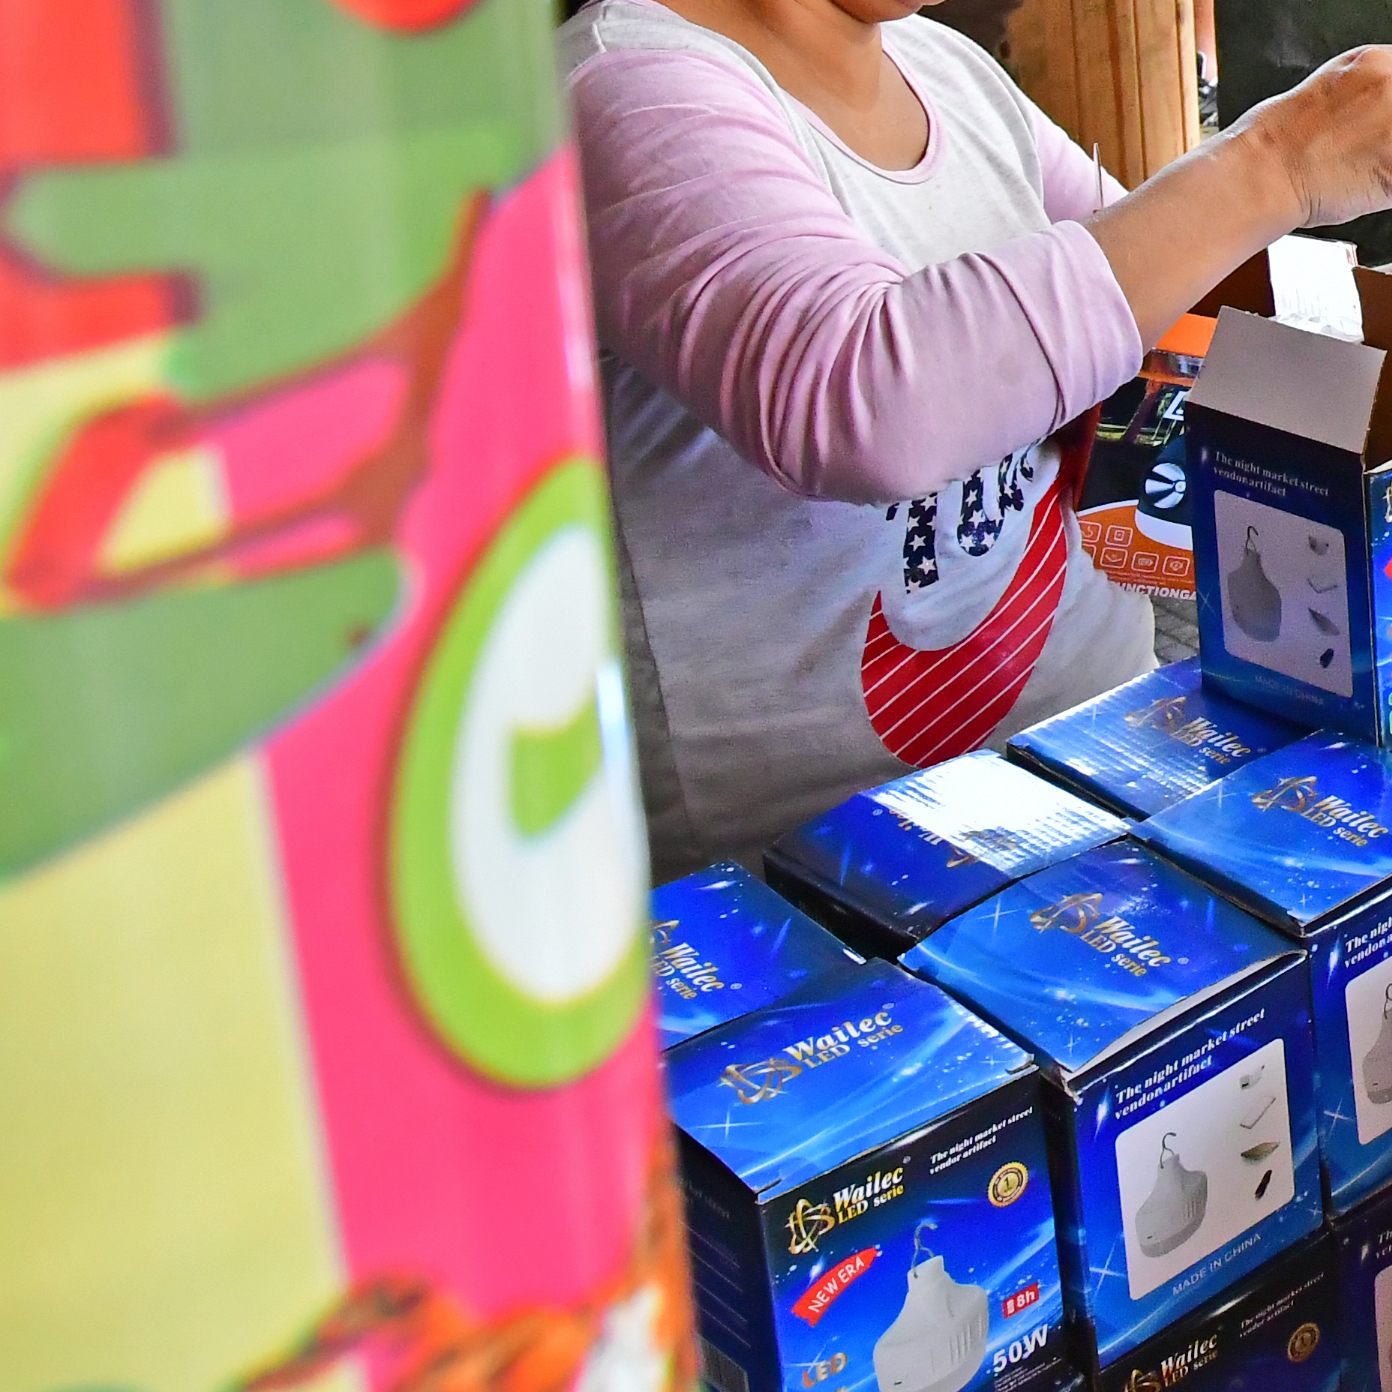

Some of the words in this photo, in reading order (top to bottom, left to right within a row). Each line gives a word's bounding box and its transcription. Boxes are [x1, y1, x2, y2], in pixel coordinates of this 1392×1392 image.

[1215, 451, 1232, 467] The
[1234, 459, 1260, 475] night
[1262, 466, 1299, 487] market
[1300, 479, 1329, 497] street
[1184, 716, 1252, 759] Wailec
[1199, 744, 1231, 765] serie
[1301, 807, 1337, 829] LED
[1332, 825, 1368, 848] serie
[1313, 795, 1389, 839] Wailec
[1080, 929, 1117, 954] LED
[1111, 953, 1148, 978] serie
[1093, 915, 1171, 967] Wailec
[1344, 939, 1385, 968] vendor
[1345, 935, 1368, 953] The
[661, 942, 725, 993] Wailec
[665, 975, 698, 1000] serie
[782, 1010, 893, 1062] Wailec
[803, 1043, 851, 1069] LED
[857, 1024, 904, 1049] serie
[1116, 1084, 1142, 1105] The
[1144, 1060, 1179, 1089] night
[1181, 1029, 1227, 1068] market
[1229, 1008, 1266, 1039] street
[1163, 1055, 1213, 1094] artifact
[929, 1156, 962, 1176] vendor
[962, 1134, 997, 1160] artifact
[930, 1151, 948, 1165] The
[949, 1136, 974, 1156] night
[974, 1117, 1007, 1144] market
[1007, 1106, 1034, 1126] street
[832, 1167, 905, 1214] Wailec
[837, 1200, 869, 1225] LED
[873, 1183, 905, 1208] serie
[807, 1279, 838, 1313] NEW
[836, 1256, 866, 1284] ERA
[1172, 1268, 1207, 1297] MADE
[1209, 1258, 1222, 1273] IN
[1225, 1233, 1262, 1263] CHINA
[1016, 1289, 1036, 1309] 8h
[801, 1351, 848, 1389] LED
[990, 1324, 1049, 1373] 50W
[1160, 1334, 1218, 1379] Wailec
